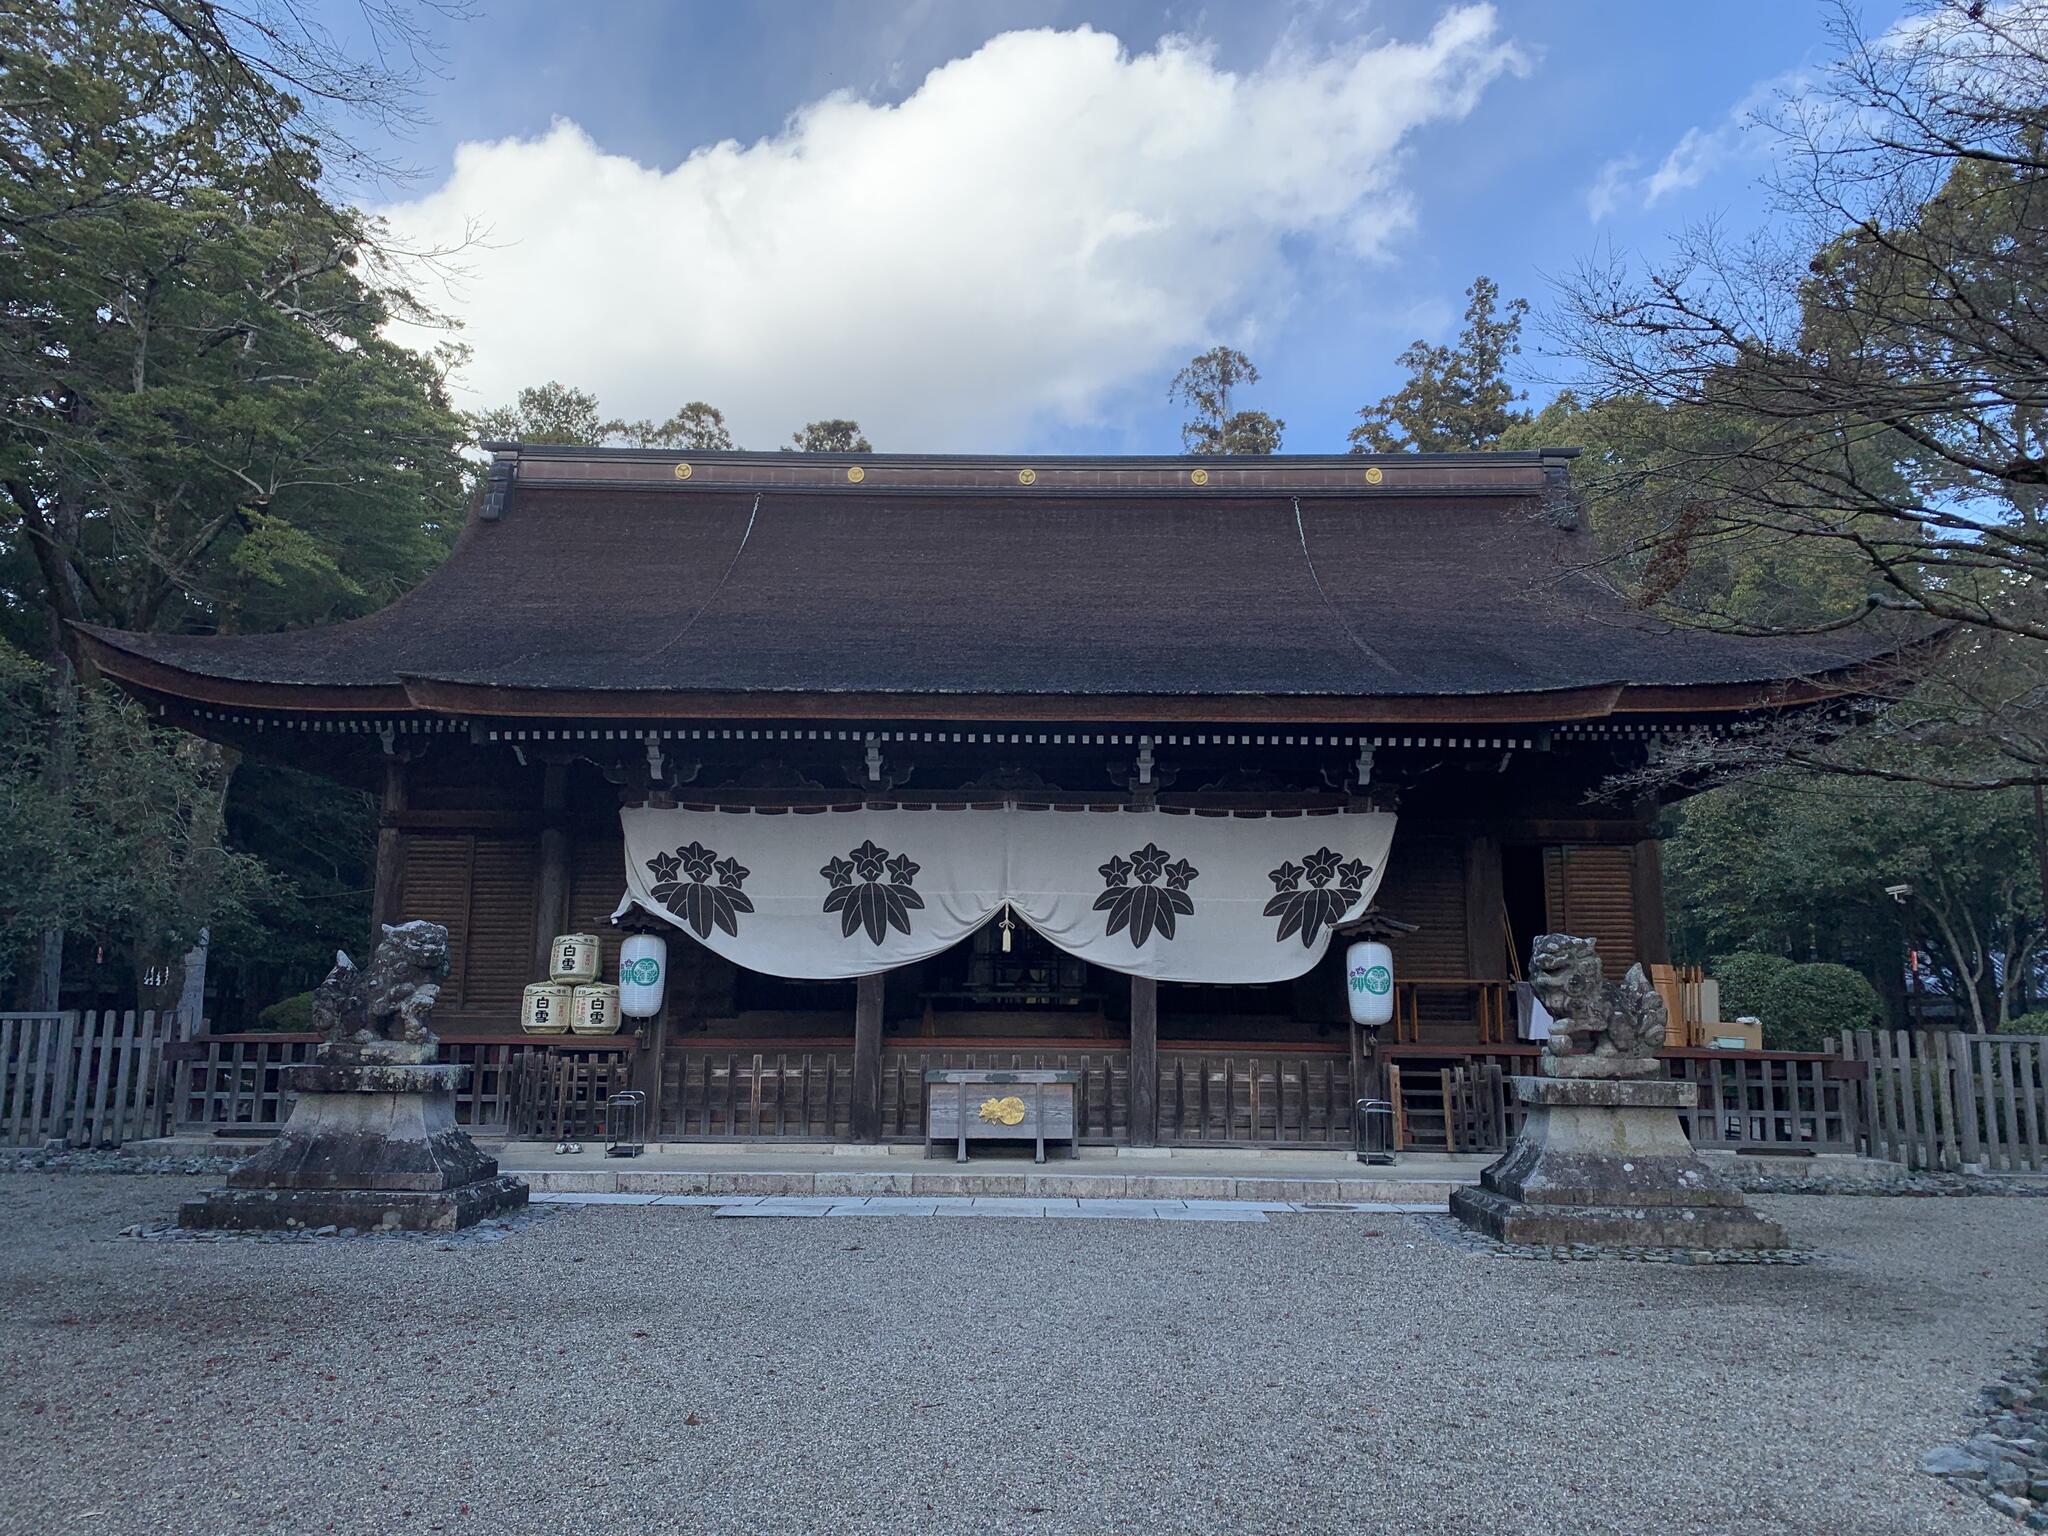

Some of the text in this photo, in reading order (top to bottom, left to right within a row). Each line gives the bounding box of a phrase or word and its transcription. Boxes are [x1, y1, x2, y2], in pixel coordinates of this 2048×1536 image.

[562, 944, 576, 970] 白雪
[535, 996, 549, 1023] 白雪
[590, 997, 605, 1024] 白雪
